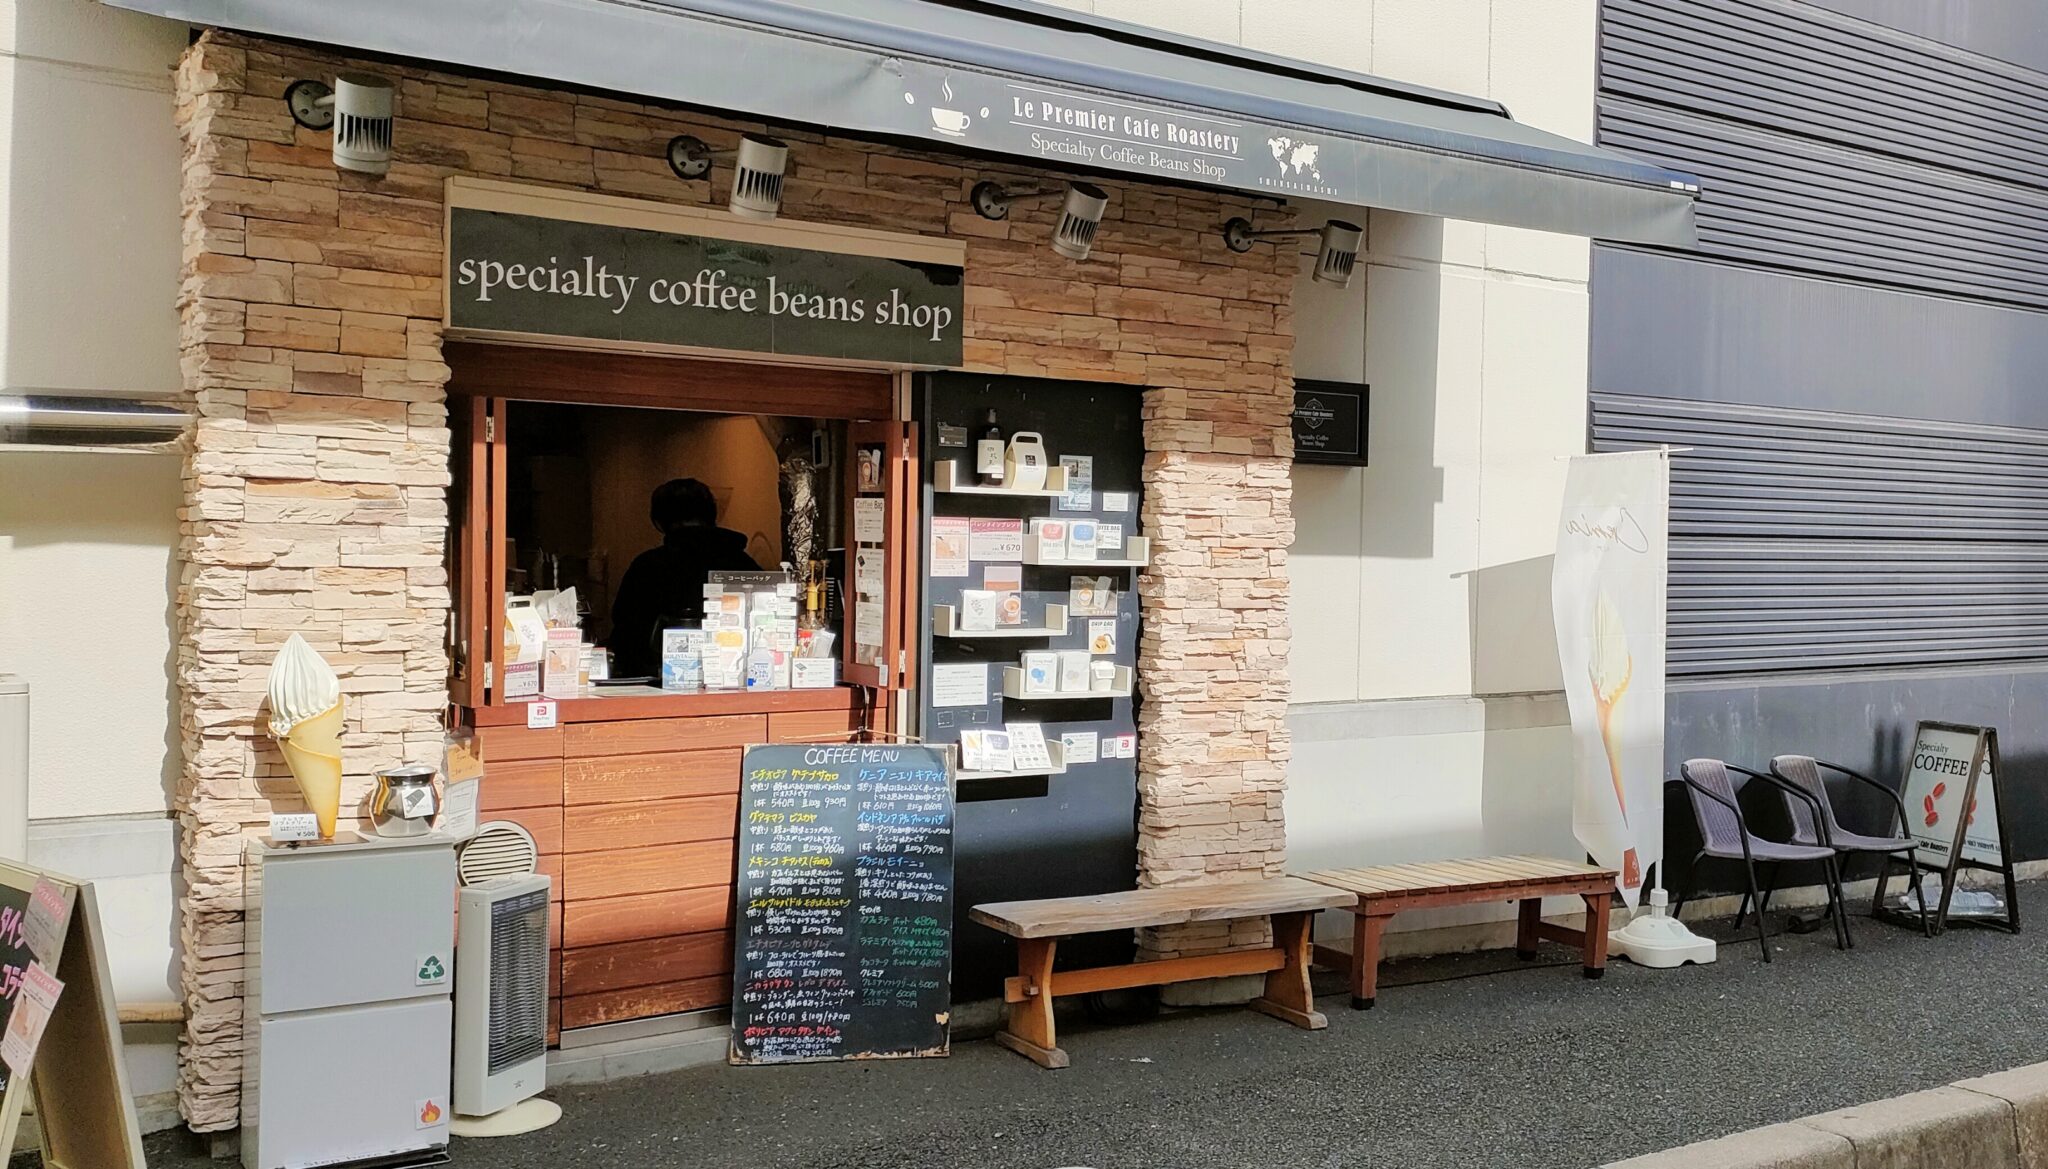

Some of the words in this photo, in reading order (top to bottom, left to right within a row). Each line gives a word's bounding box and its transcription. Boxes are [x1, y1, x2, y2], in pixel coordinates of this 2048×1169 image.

[1013, 96, 1034, 118] Le
[1042, 102, 1116, 132] Premier
[1123, 116, 1160, 140] Cafe
[1167, 123, 1239, 153] Roastery
[1031, 132, 1096, 161] Specialty
[1100, 144, 1145, 165] Coffee
[1149, 151, 1189, 172] Beans
[1193, 158, 1226, 181] Shop
[457, 256, 639, 314] specialty
[649, 268, 757, 313] coffee
[769, 275, 865, 323] beans
[875, 288, 952, 342] shop
[1000, 543, 1021, 552] ¥670
[1917, 740, 1949, 755] Specialty
[804, 748, 859, 765] COFFEE
[861, 748, 900, 763] MENU
[1914, 754, 1969, 776] COFFEE
[859, 769, 887, 781] ケニア
[889, 772, 913, 782] ニエリ
[771, 798, 795, 809] 540円
[824, 796, 847, 809] 930円
[873, 801, 895, 811] 610円
[857, 811, 897, 824] インドネシア
[770, 842, 792, 853] 580円
[823, 843, 845, 855] 960円
[875, 843, 897, 853] 460円
[922, 844, 944, 855] 790円
[748, 856, 779, 868] メキシコ
[856, 855, 886, 866] ブラジル
[768, 886, 792, 896] 470円
[821, 886, 842, 896] 810円
[873, 889, 898, 899] 460円
[921, 891, 943, 903] 780円
[859, 905, 881, 915] その他
[914, 915, 938, 926] 480円
[768, 925, 791, 935] 530円
[822, 926, 844, 936] 870円
[767, 967, 793, 978] 680円
[860, 968, 885, 978] クレミア
[919, 980, 940, 988] 500円
[896, 989, 918, 998] 600円
[767, 1011, 796, 1024] 640円
